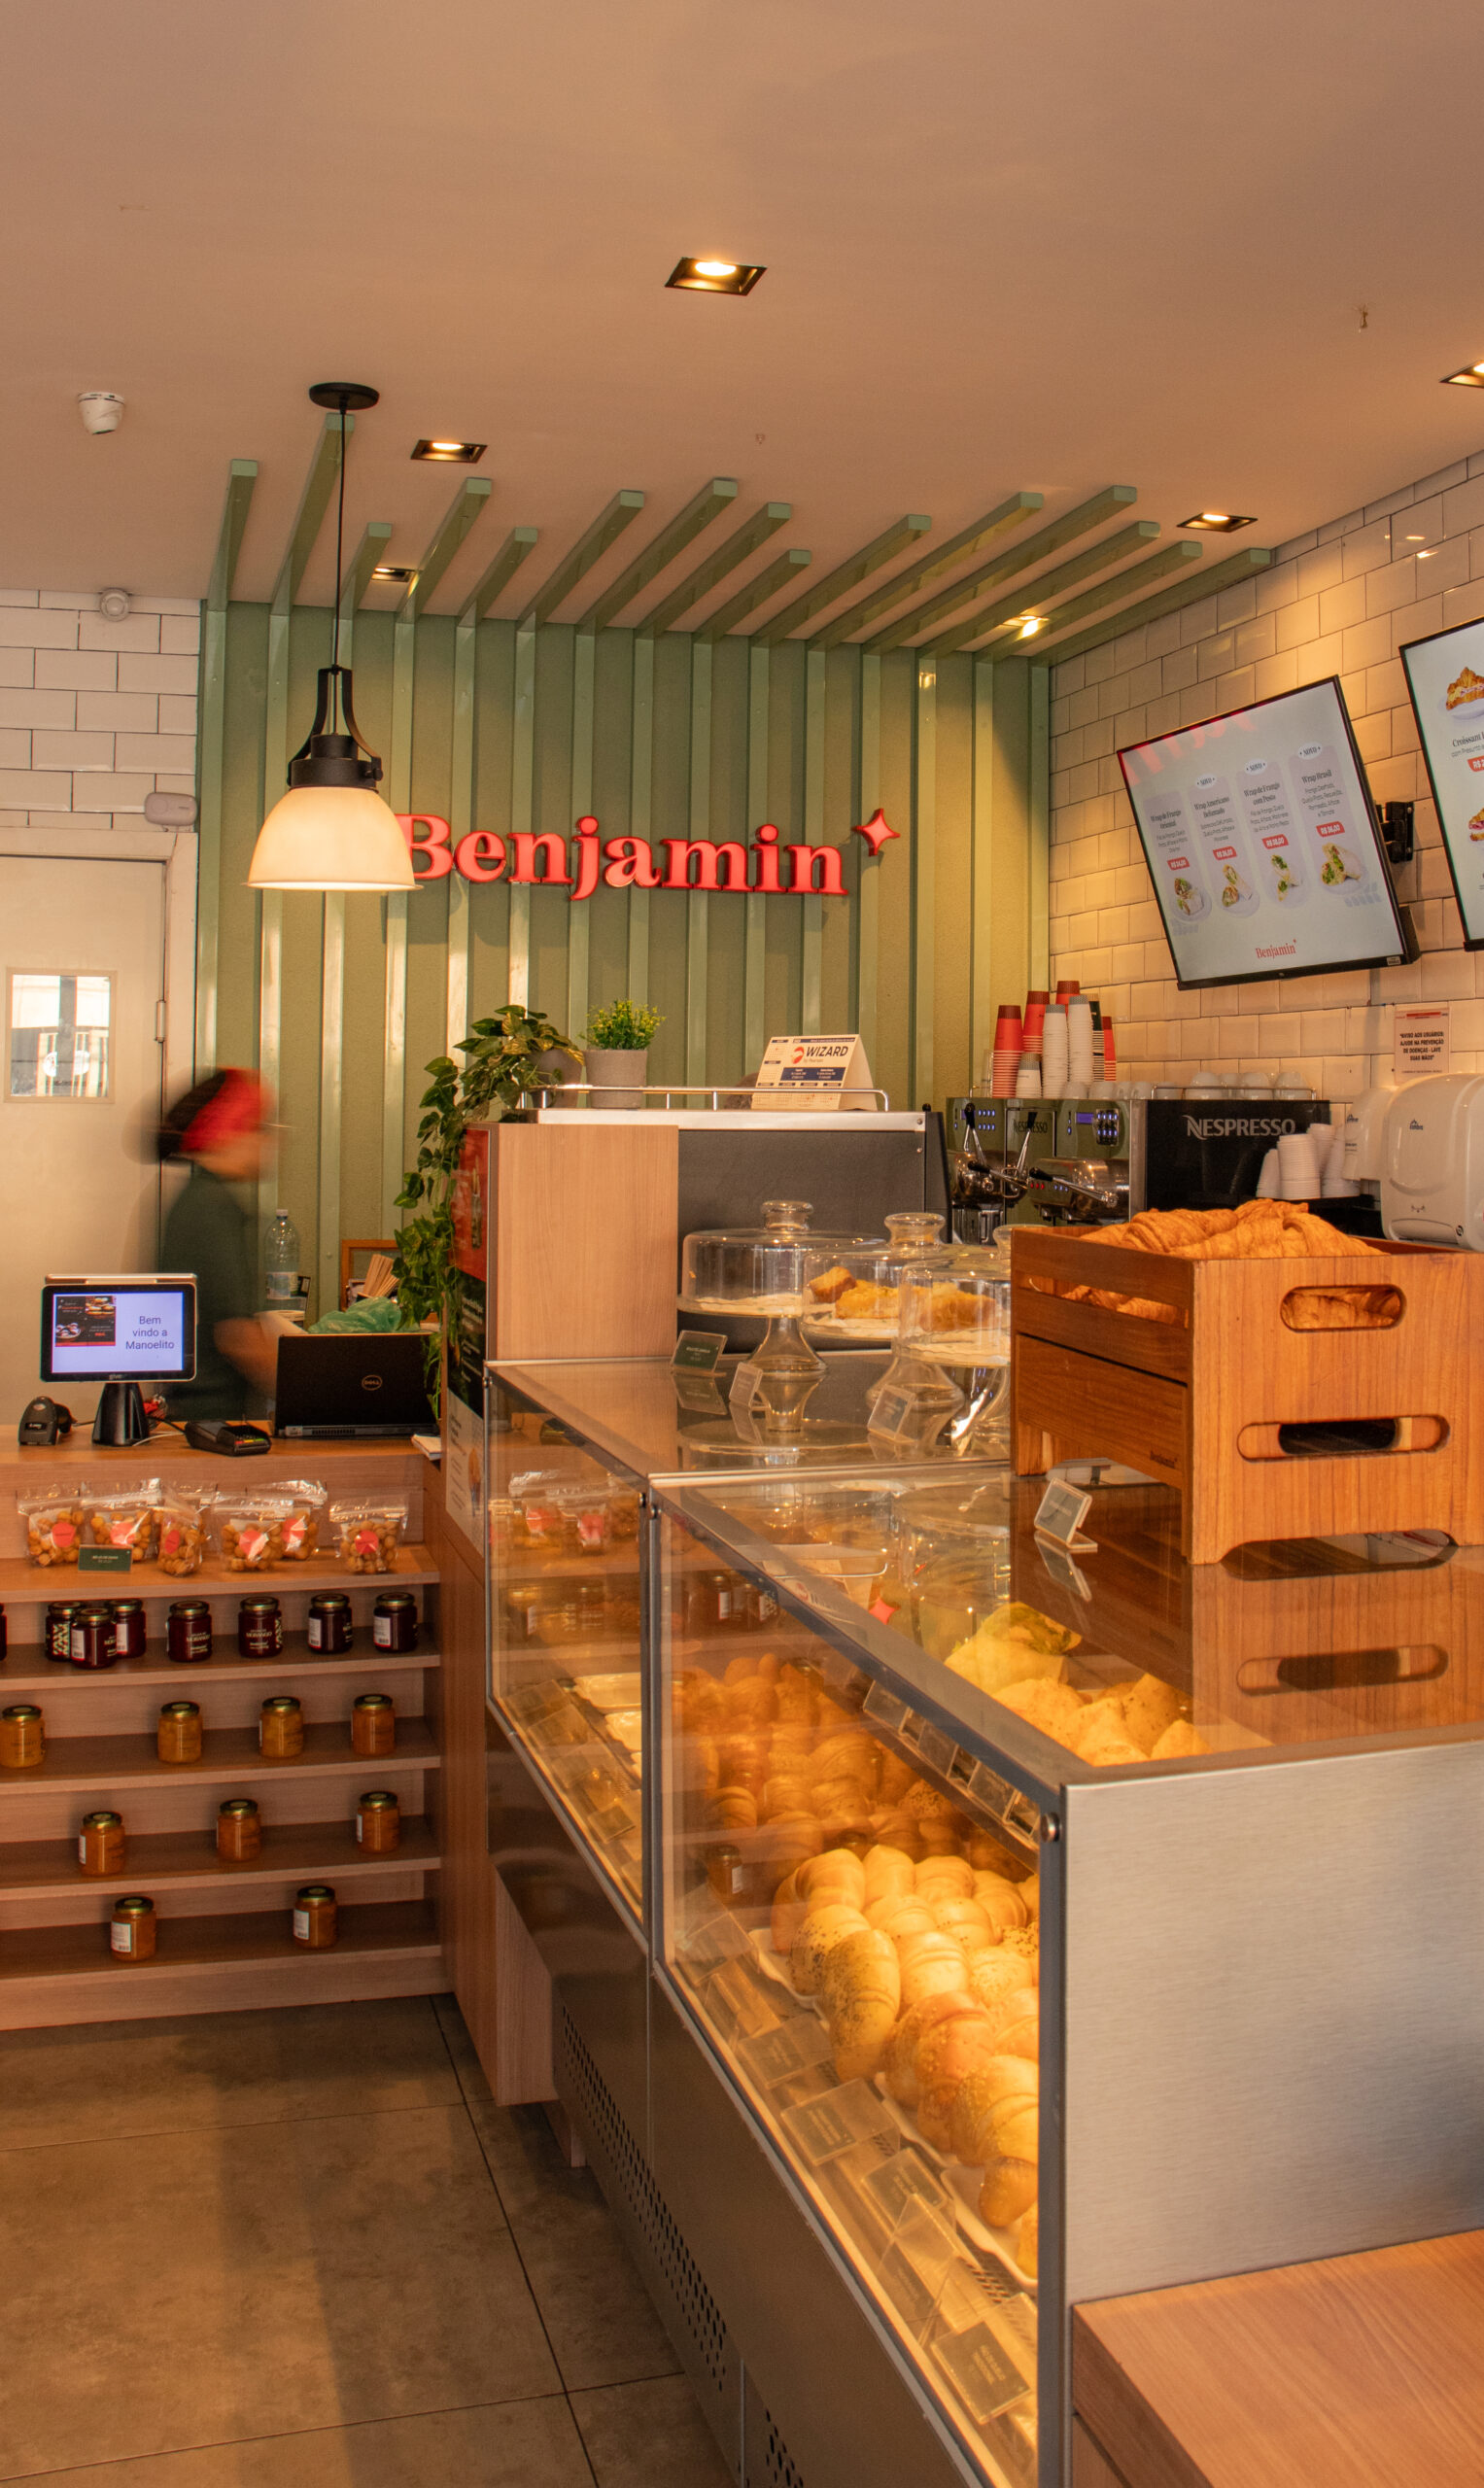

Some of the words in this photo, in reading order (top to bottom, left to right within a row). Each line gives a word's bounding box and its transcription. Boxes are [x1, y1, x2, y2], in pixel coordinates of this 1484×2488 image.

[396, 815, 848, 902] Benjamin
[1256, 943, 1296, 959] Benjamin
[807, 1046, 849, 1057] WIZARD
[1182, 1115, 1296, 1141] NESPRESSO
[139, 1316, 161, 1325] Bem
[132, 1328, 159, 1337] vindo
[125, 1340, 175, 1350] Manoelito
